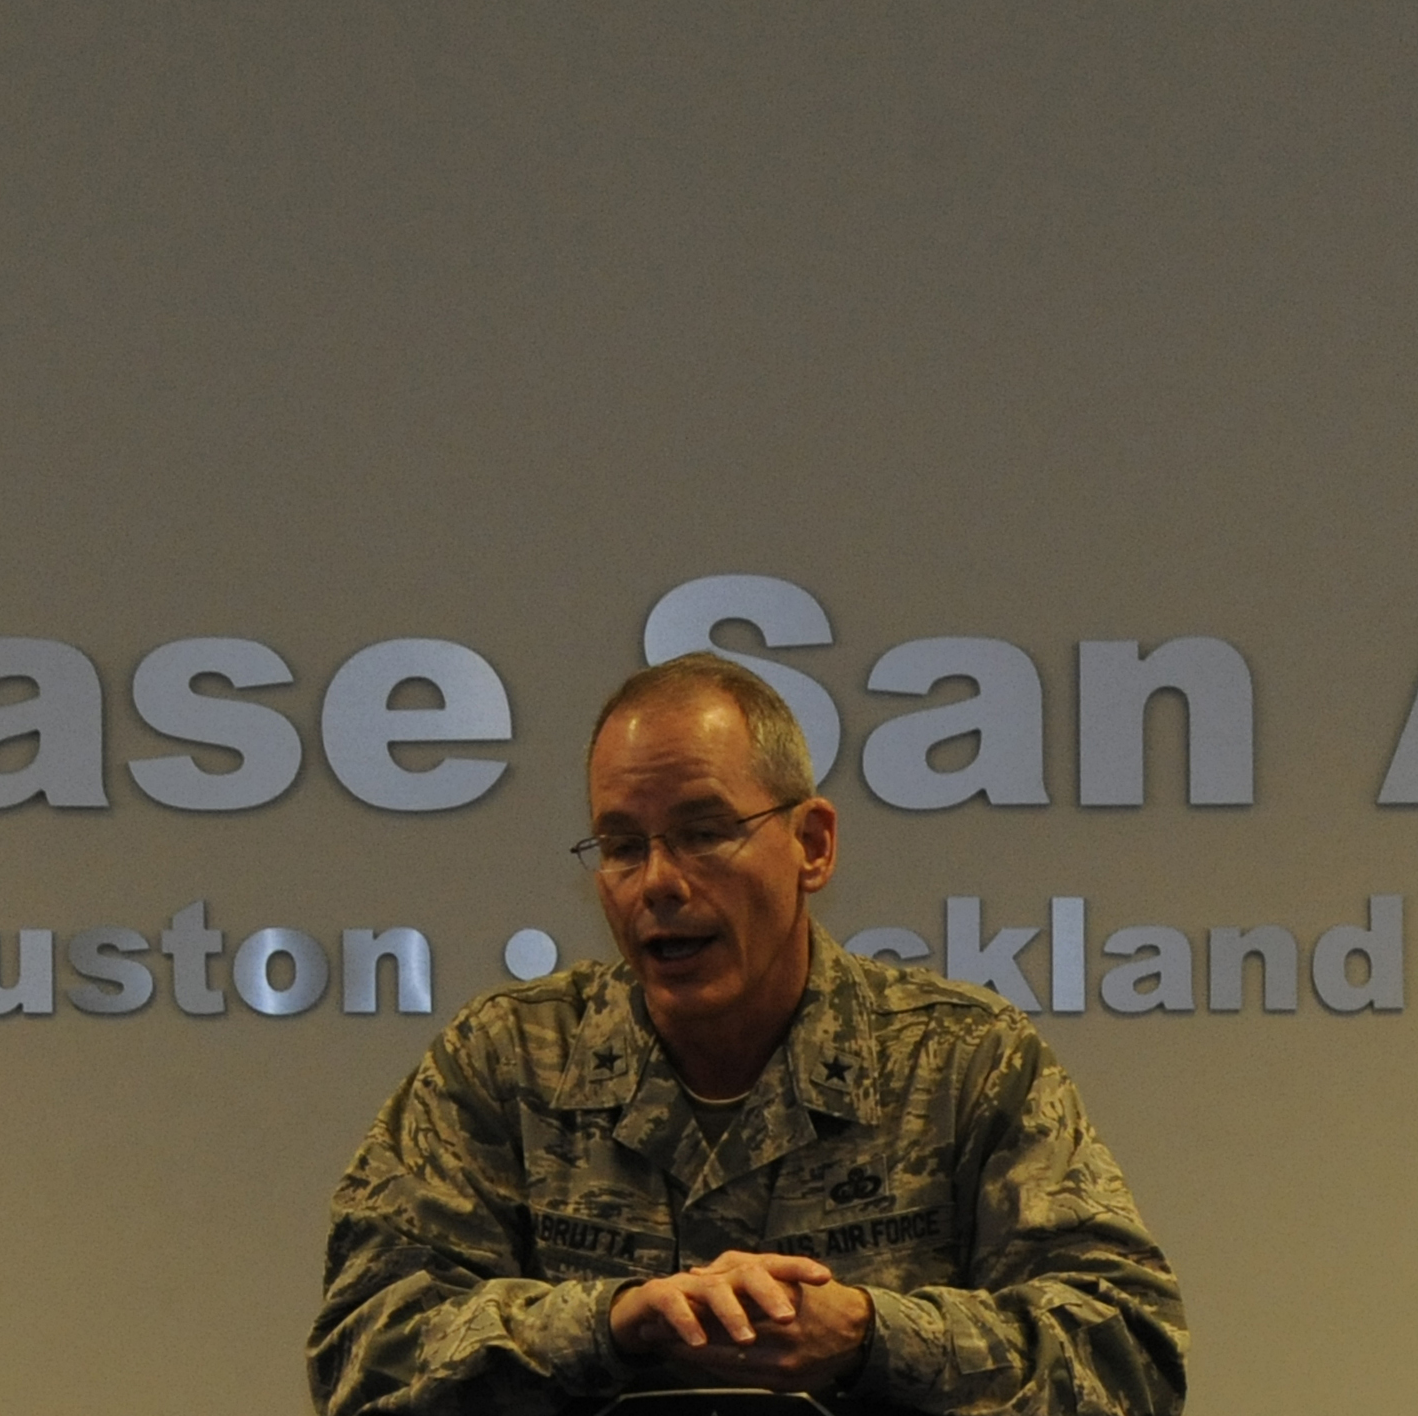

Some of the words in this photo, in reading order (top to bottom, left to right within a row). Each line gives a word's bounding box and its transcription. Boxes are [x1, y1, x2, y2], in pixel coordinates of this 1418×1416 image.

[644, 573, 1254, 810] San
[534, 1212, 636, 1259] BRUTTA
[826, 1223, 866, 1256] AIR
[871, 1209, 940, 1247] FORCE
